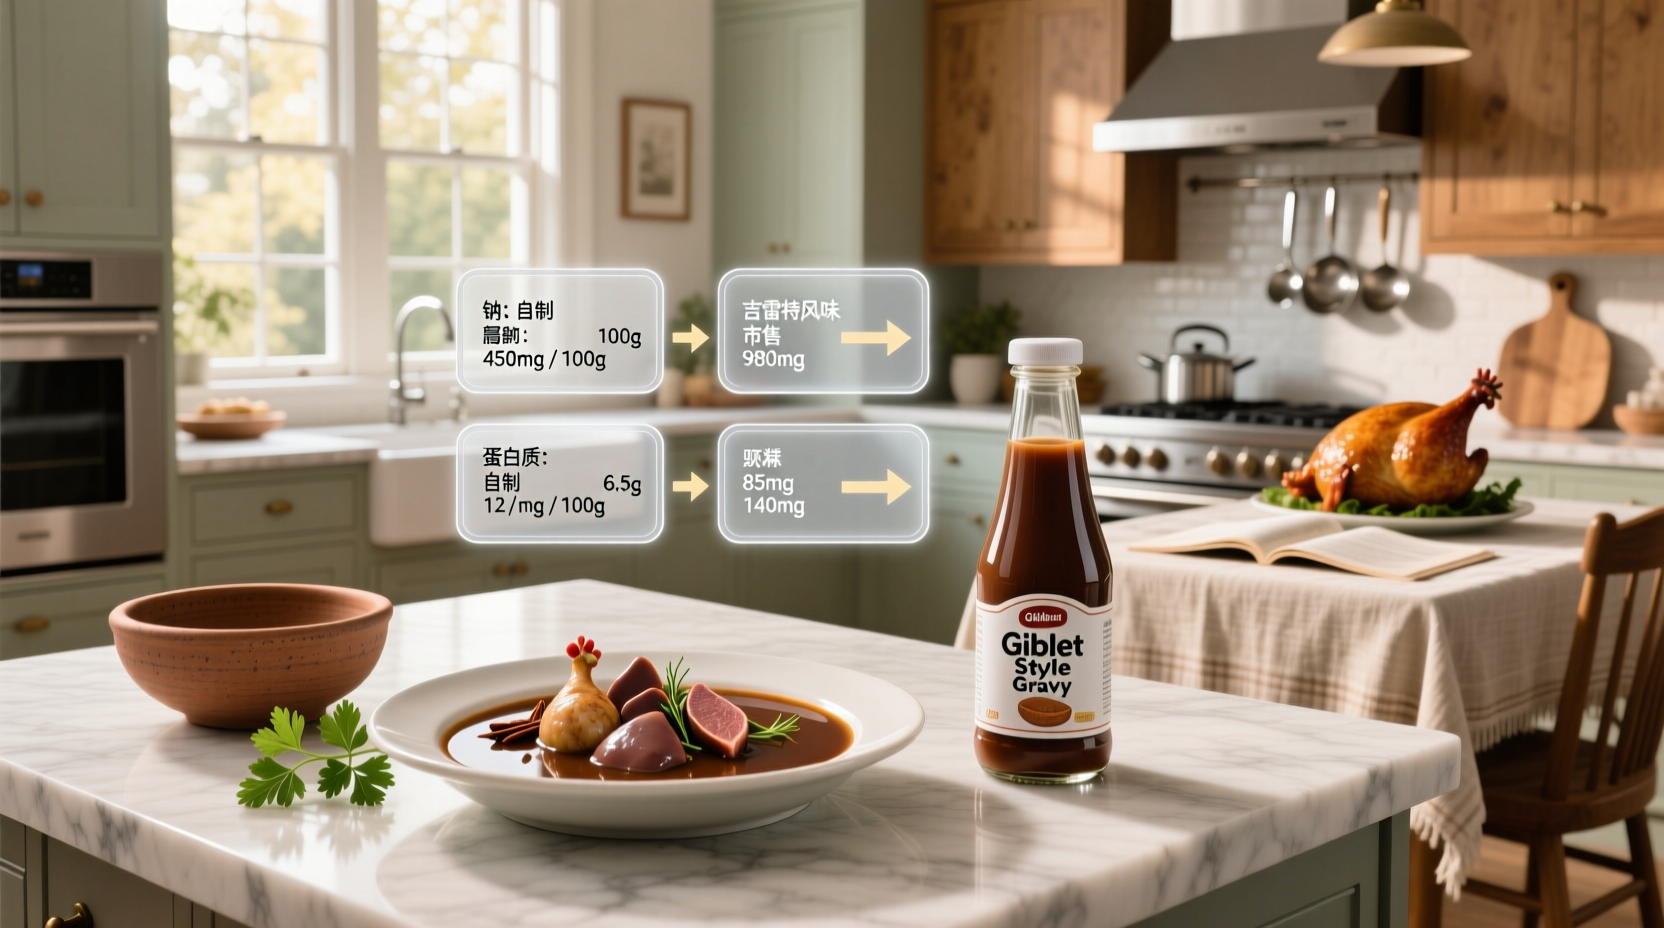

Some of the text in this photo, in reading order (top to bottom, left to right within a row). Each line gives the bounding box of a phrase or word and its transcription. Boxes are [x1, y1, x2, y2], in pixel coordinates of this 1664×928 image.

[1001, 631, 1084, 657] Giblet
[1014, 657, 1071, 680] Style
[1012, 676, 1072, 698] Gravy
